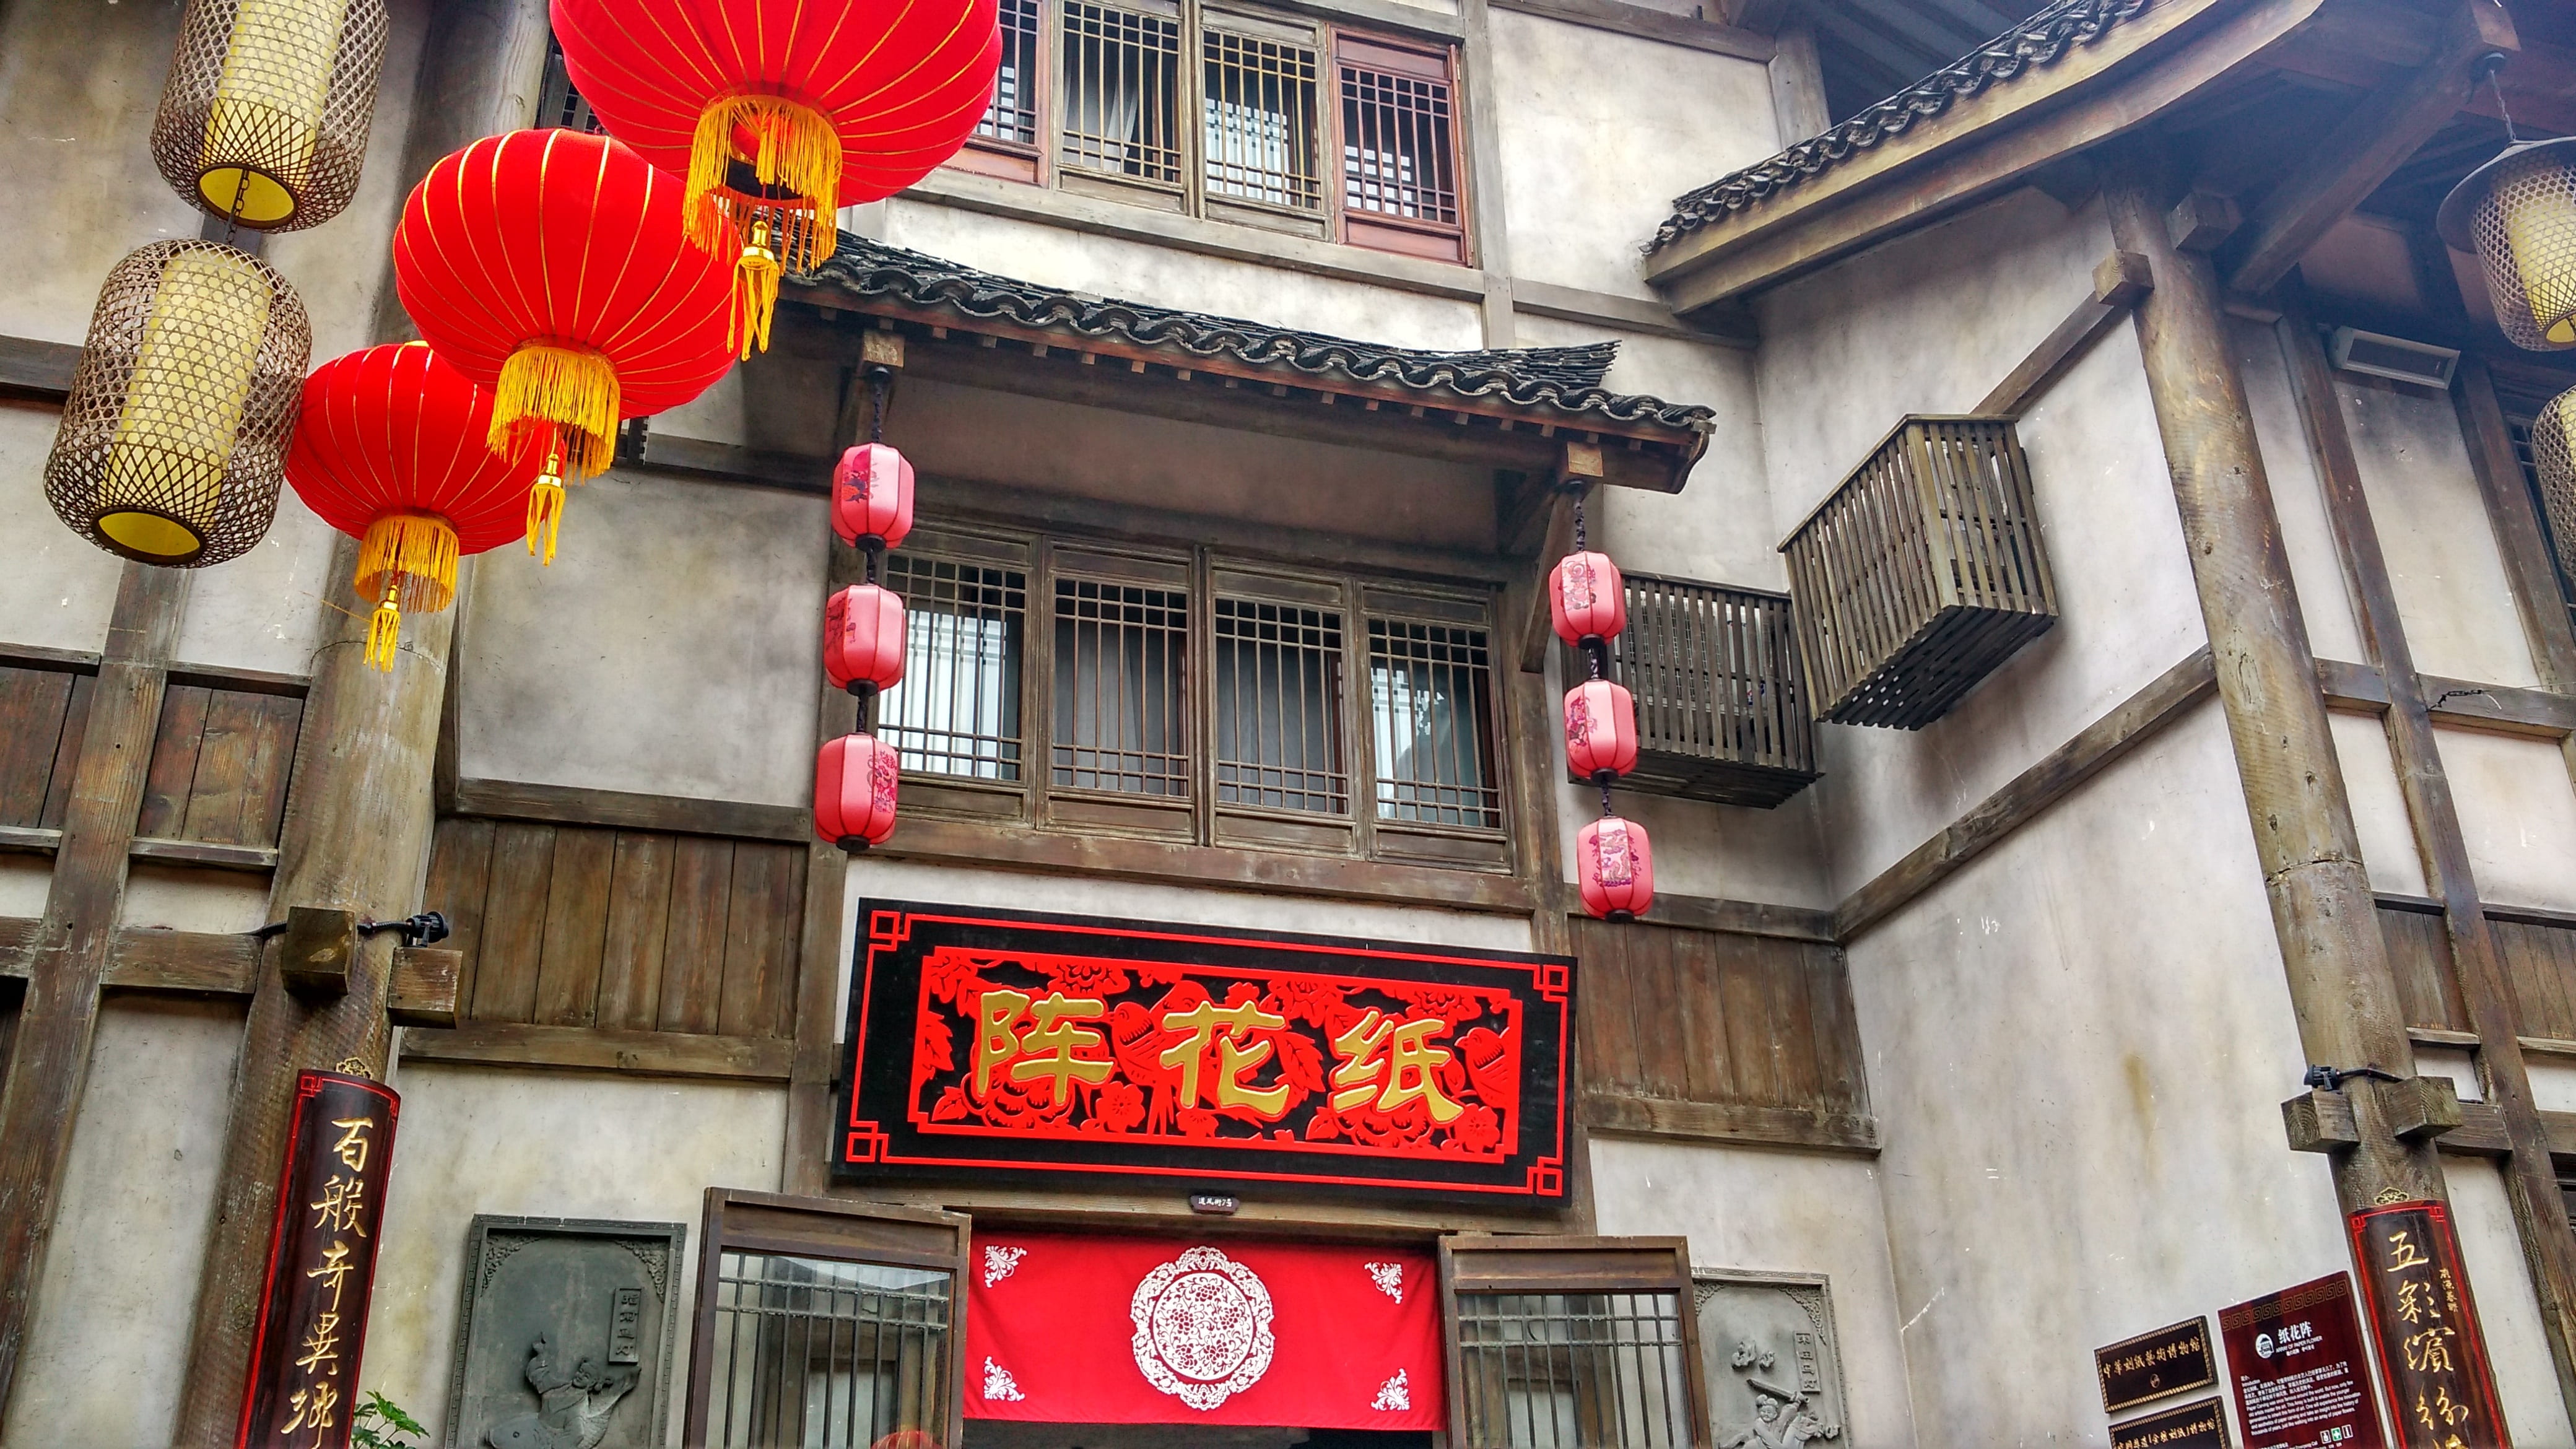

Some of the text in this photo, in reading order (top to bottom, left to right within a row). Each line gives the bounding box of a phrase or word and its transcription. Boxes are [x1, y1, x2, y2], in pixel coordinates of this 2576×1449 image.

[2278, 1320, 2313, 1344] 纸花阵
[2294, 1339, 2307, 1349] PAPER
[2306, 1335, 2323, 1345] FLOWER
